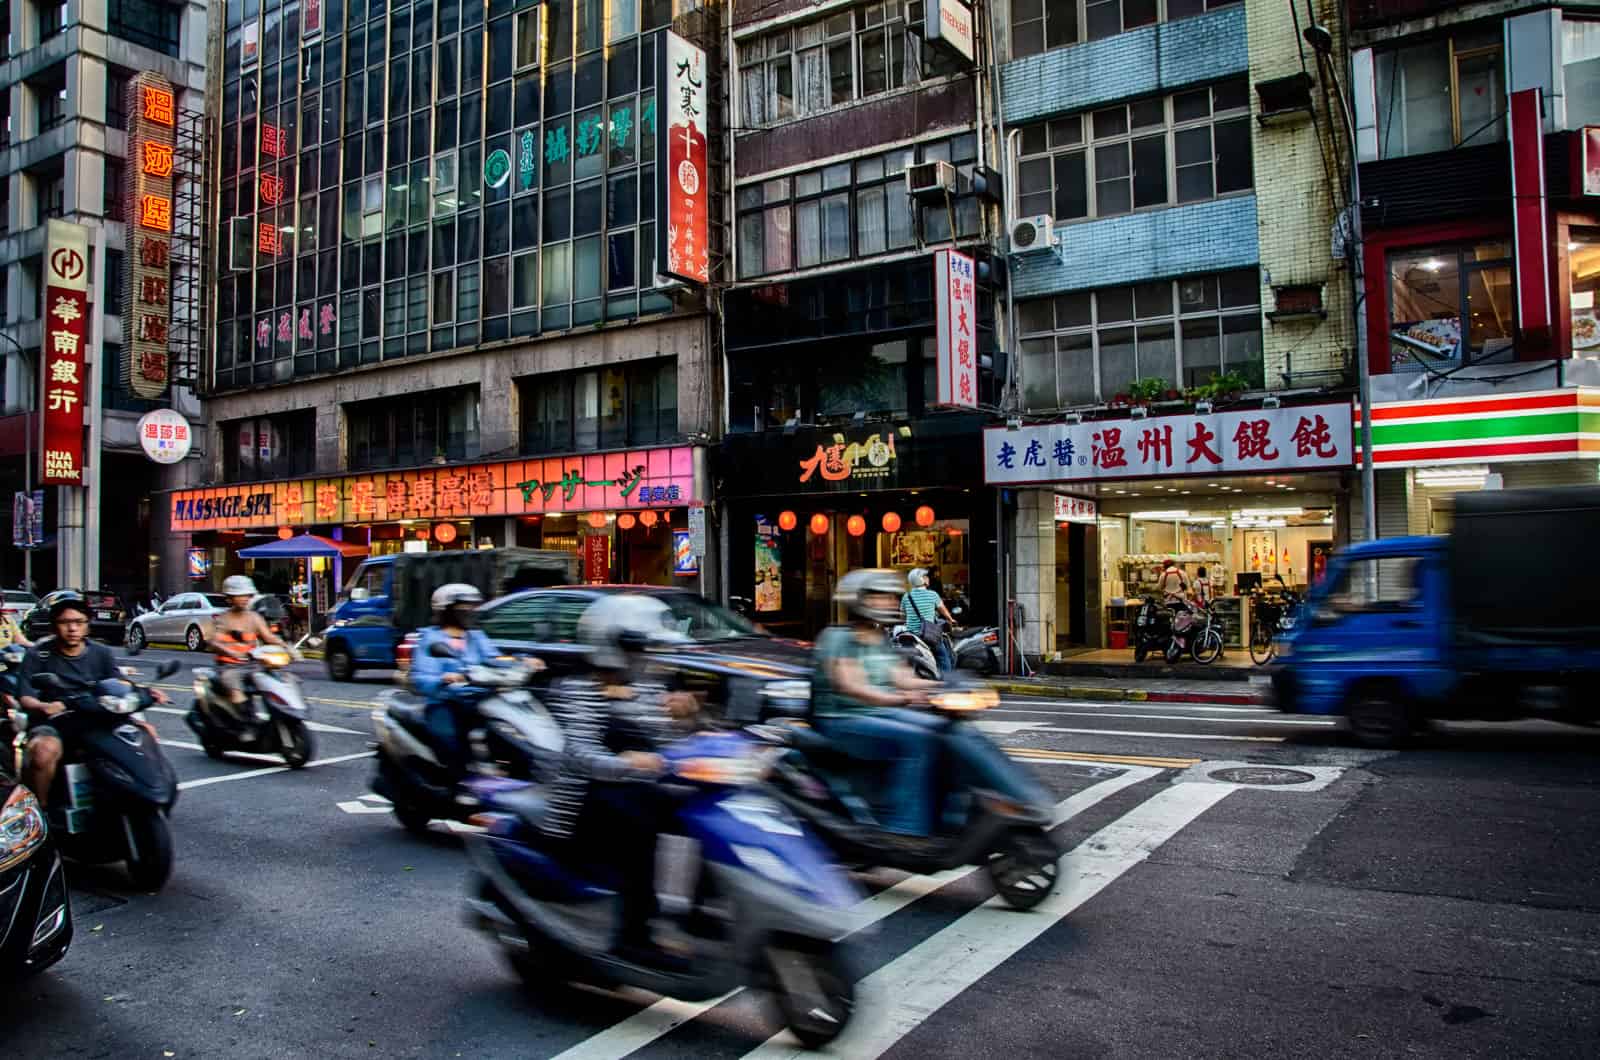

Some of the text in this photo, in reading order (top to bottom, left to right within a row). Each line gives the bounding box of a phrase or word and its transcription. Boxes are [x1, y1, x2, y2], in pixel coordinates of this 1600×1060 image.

[48, 295, 82, 414] 華南銀行
[46, 450, 72, 461] HUA
[46, 460, 73, 471] NAN
[46, 469, 81, 480] BANK
[516, 465, 645, 503] マッサージ
[175, 493, 273, 520] MASSAGE SPA
